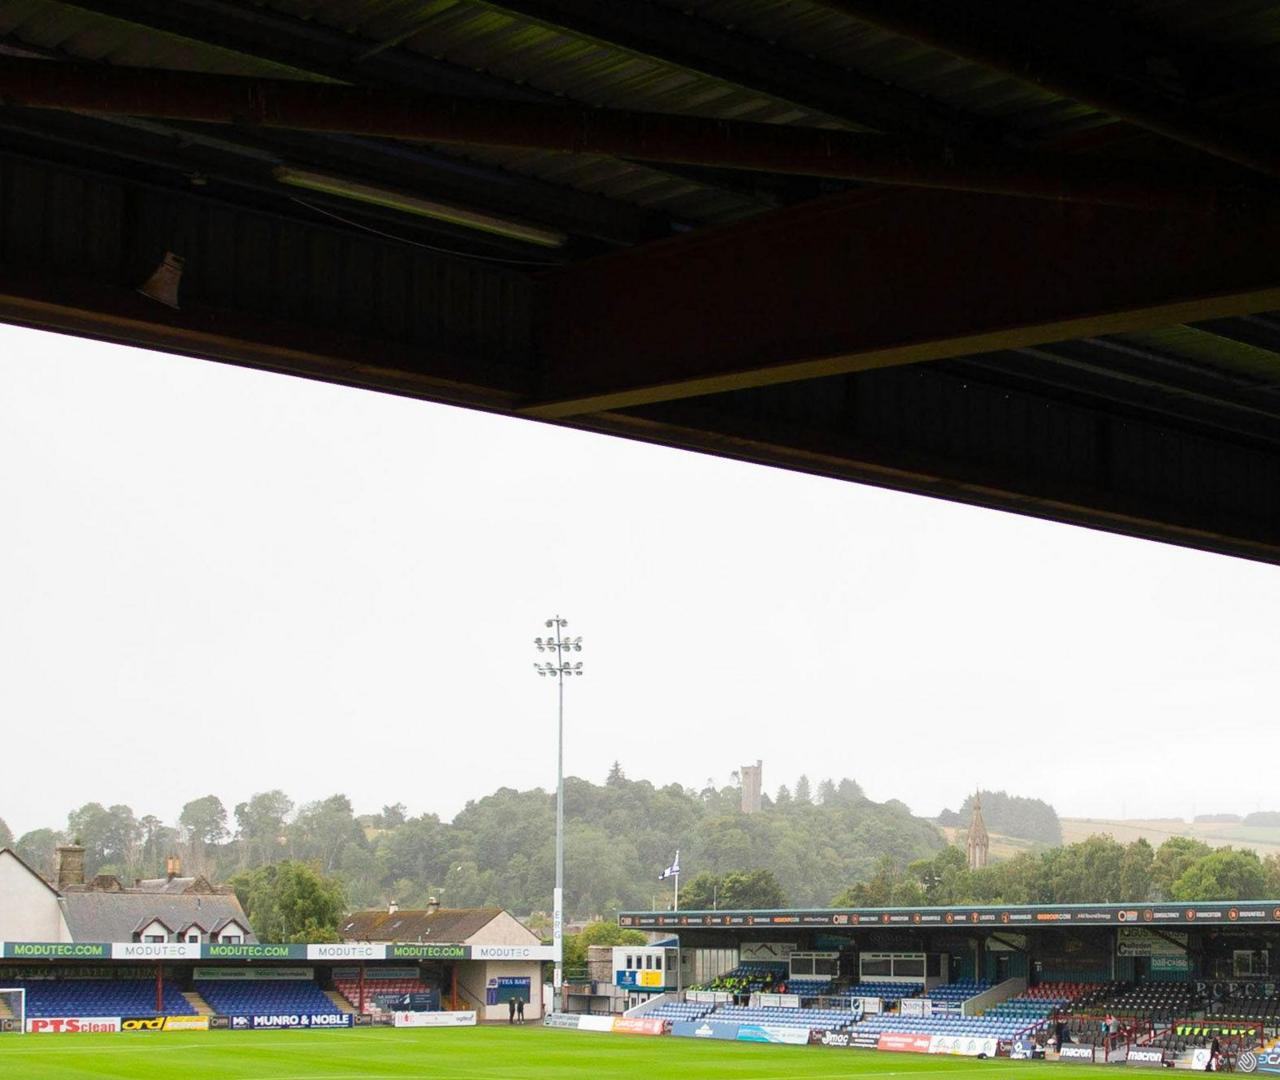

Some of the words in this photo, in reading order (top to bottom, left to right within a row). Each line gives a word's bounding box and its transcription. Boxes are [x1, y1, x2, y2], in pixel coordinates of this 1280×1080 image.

[14, 944, 103, 955] MODUTEC.COM
[210, 946, 289, 957] MODUTEC.COM
[394, 947, 464, 957] MODUTEC.COM
[253, 1014, 299, 1026] MUNRO
[300, 1015, 309, 1025] &
[310, 1014, 350, 1025] NOBLE
[32, 1019, 80, 1033] PTS
[81, 1021, 116, 1033] clean
[1061, 1047, 1092, 1058] macron
[1127, 1051, 1162, 1062] macron
